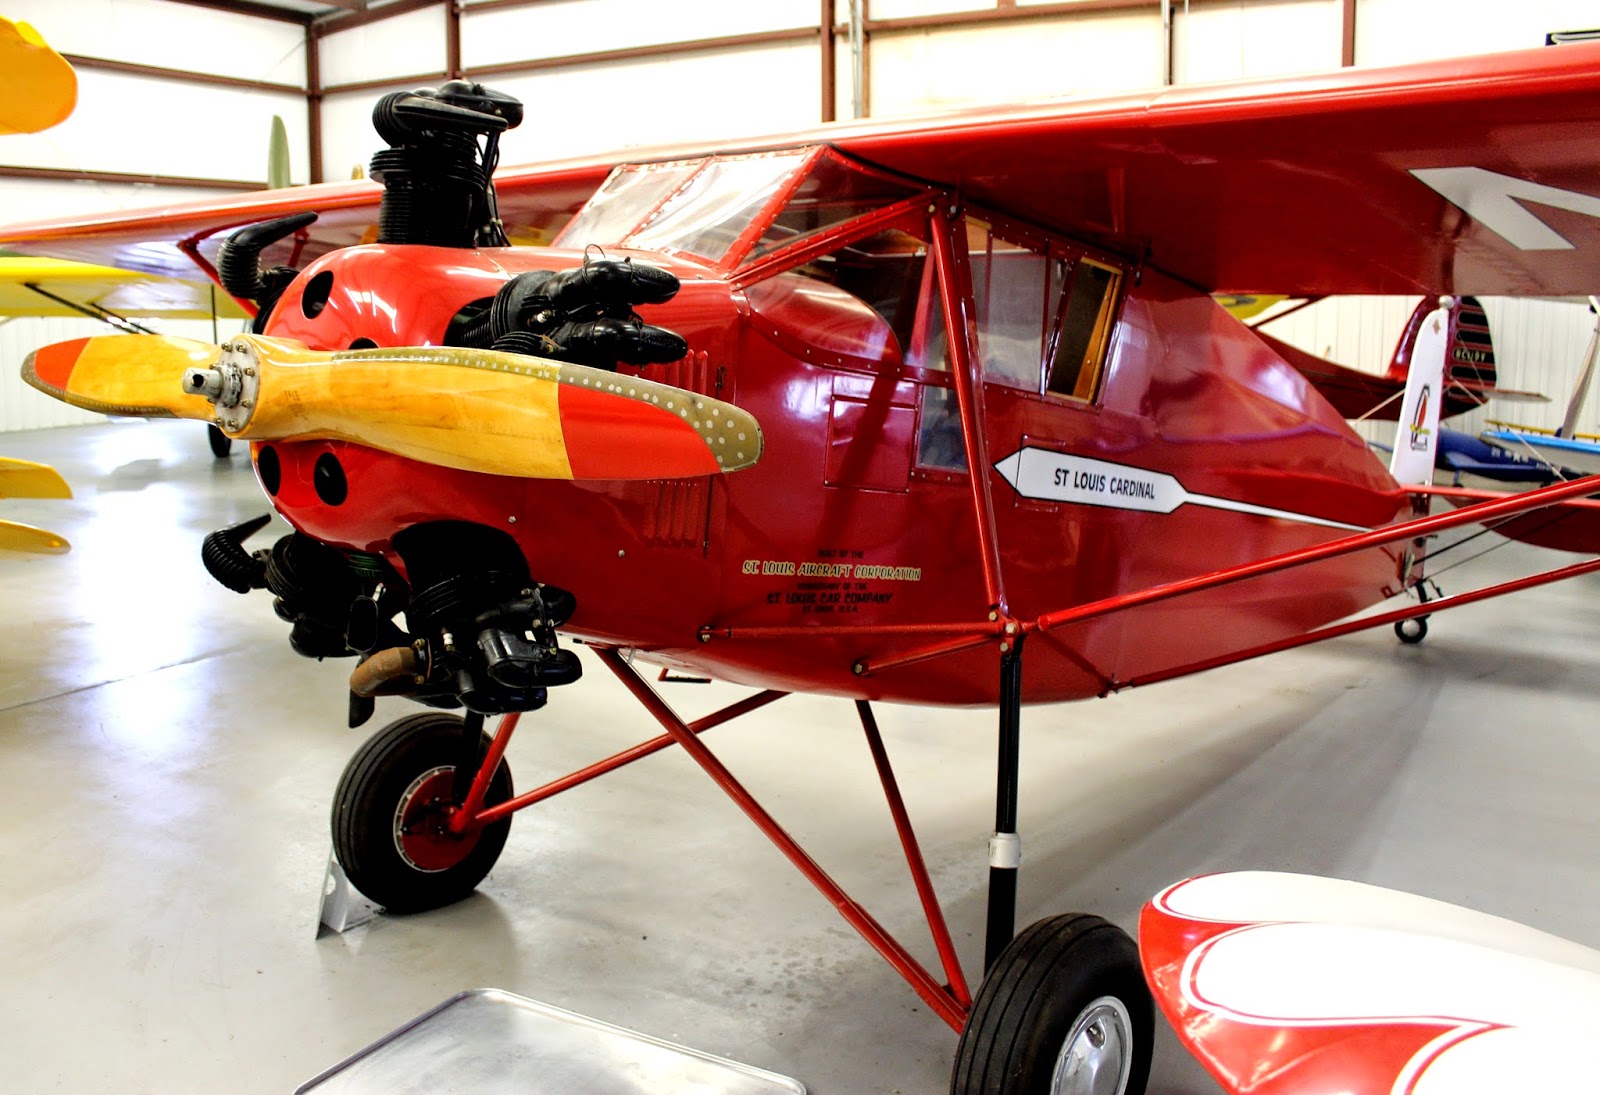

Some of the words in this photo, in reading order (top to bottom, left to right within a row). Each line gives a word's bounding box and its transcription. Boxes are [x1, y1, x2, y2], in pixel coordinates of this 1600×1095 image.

[1054, 468, 1070, 487] ST
[1073, 471, 1106, 493] LOUIS
[1110, 476, 1155, 500] CARDINAL
[762, 561, 795, 575] LOUIS
[797, 562, 853, 578] AIRCRAFT
[854, 565, 921, 581] CORPORATION
[785, 592, 816, 604] LOUIS
[820, 592, 841, 604] CAR
[844, 592, 893, 604] COMPANY
